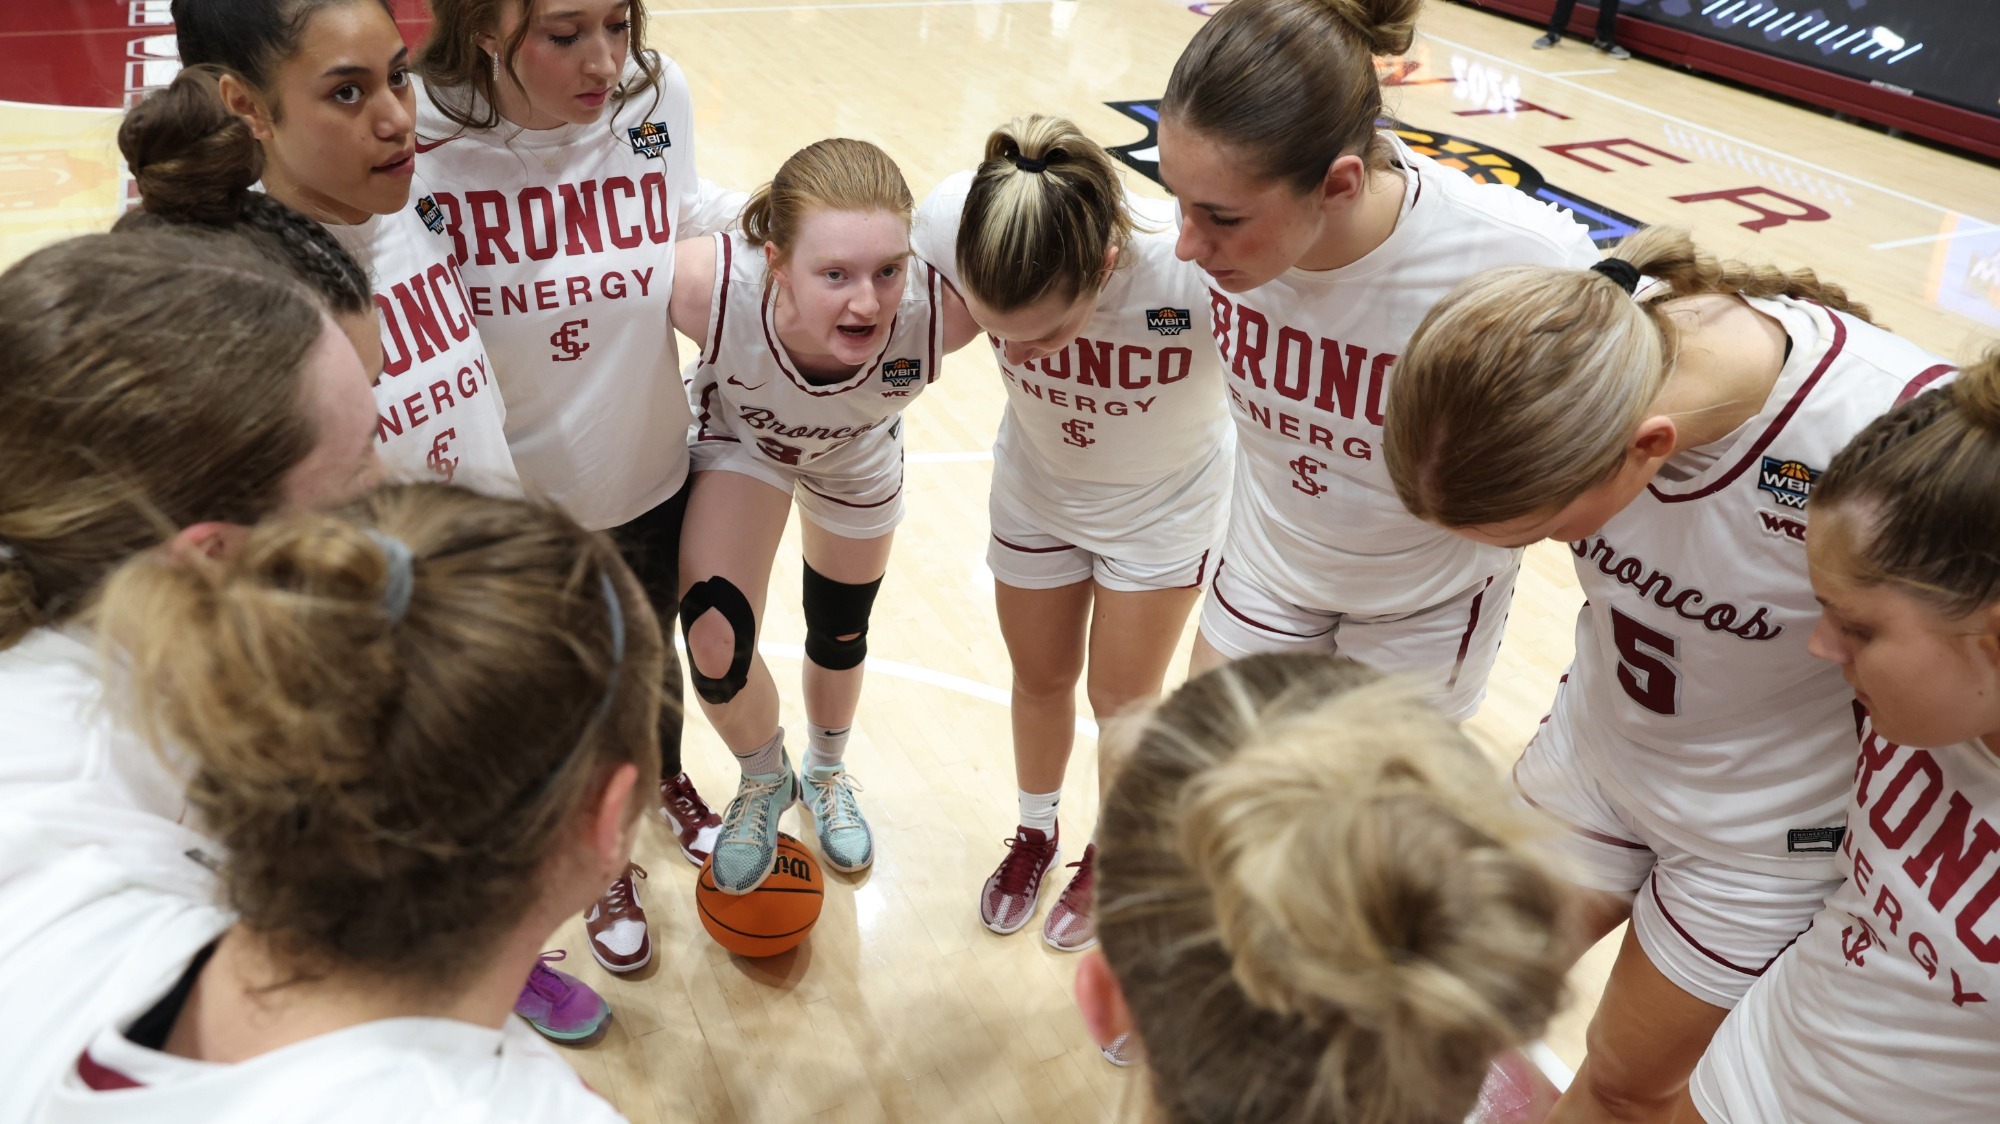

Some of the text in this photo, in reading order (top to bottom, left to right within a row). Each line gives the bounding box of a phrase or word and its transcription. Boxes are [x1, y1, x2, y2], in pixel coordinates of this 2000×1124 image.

[633, 133, 667, 148] WBIT
[433, 172, 671, 267] BRONCO
[469, 267, 654, 316] ENERGY
[1148, 317, 1189, 327] WBIT
[884, 368, 919, 378] WBIT
[376, 354, 488, 444] NERGY
[1228, 382, 1385, 461] ENERG
[1763, 471, 1816, 494] WBI
[1610, 604, 1681, 716] 5
